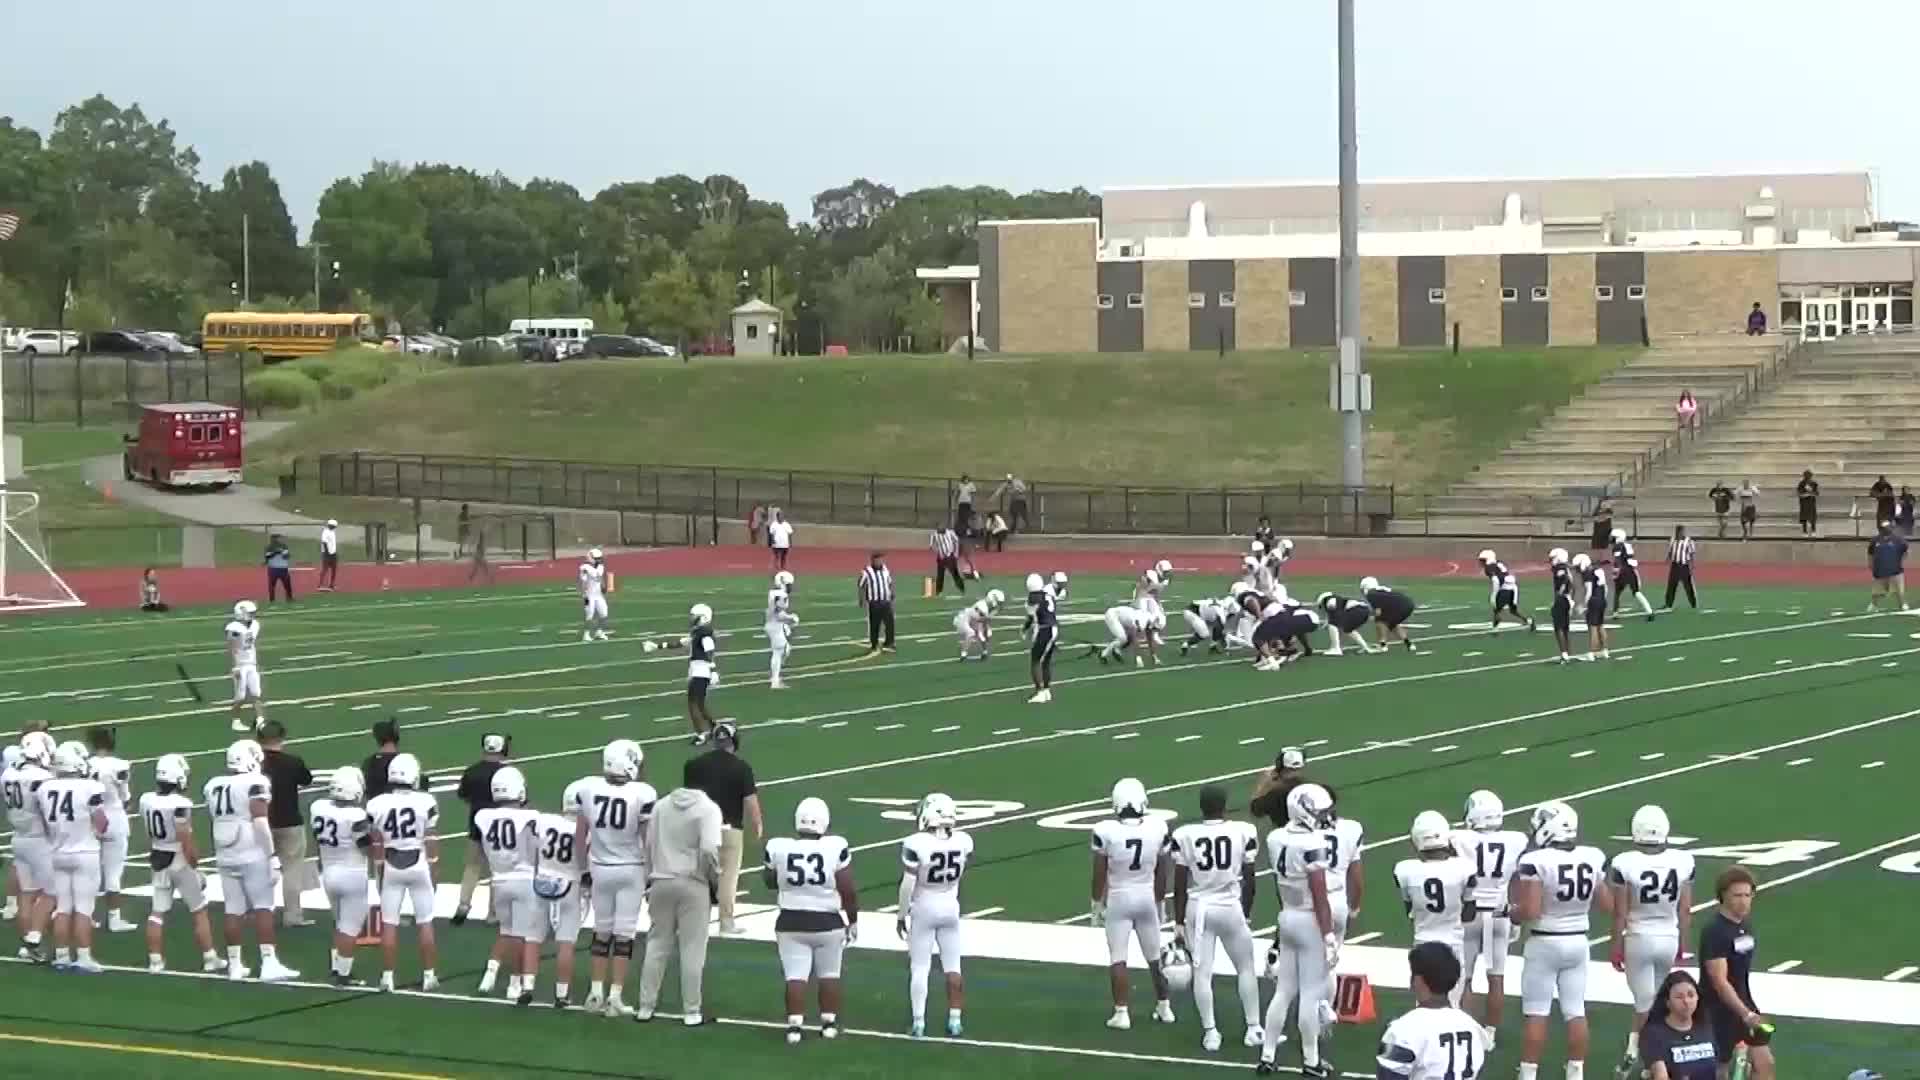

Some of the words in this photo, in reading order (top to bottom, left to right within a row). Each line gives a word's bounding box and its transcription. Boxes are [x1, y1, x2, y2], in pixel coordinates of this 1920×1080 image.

[47, 790, 74, 821] 74
[212, 785, 235, 816] 71
[594, 795, 626, 830] 70
[145, 811, 166, 841] 10
[313, 815, 339, 847] 23
[384, 808, 417, 839] 42
[486, 819, 517, 851] 40
[541, 827, 573, 864] 38
[1126, 838, 1143, 871] 7
[1195, 836, 1233, 872] 30
[1476, 843, 1505, 878] 17
[786, 853, 826, 887] 53
[927, 850, 961, 884] 25
[1557, 863, 1593, 902] 56
[1423, 877, 1445, 913] 9
[1640, 869, 1678, 904] 24
[1439, 1031, 1473, 1080] 77
